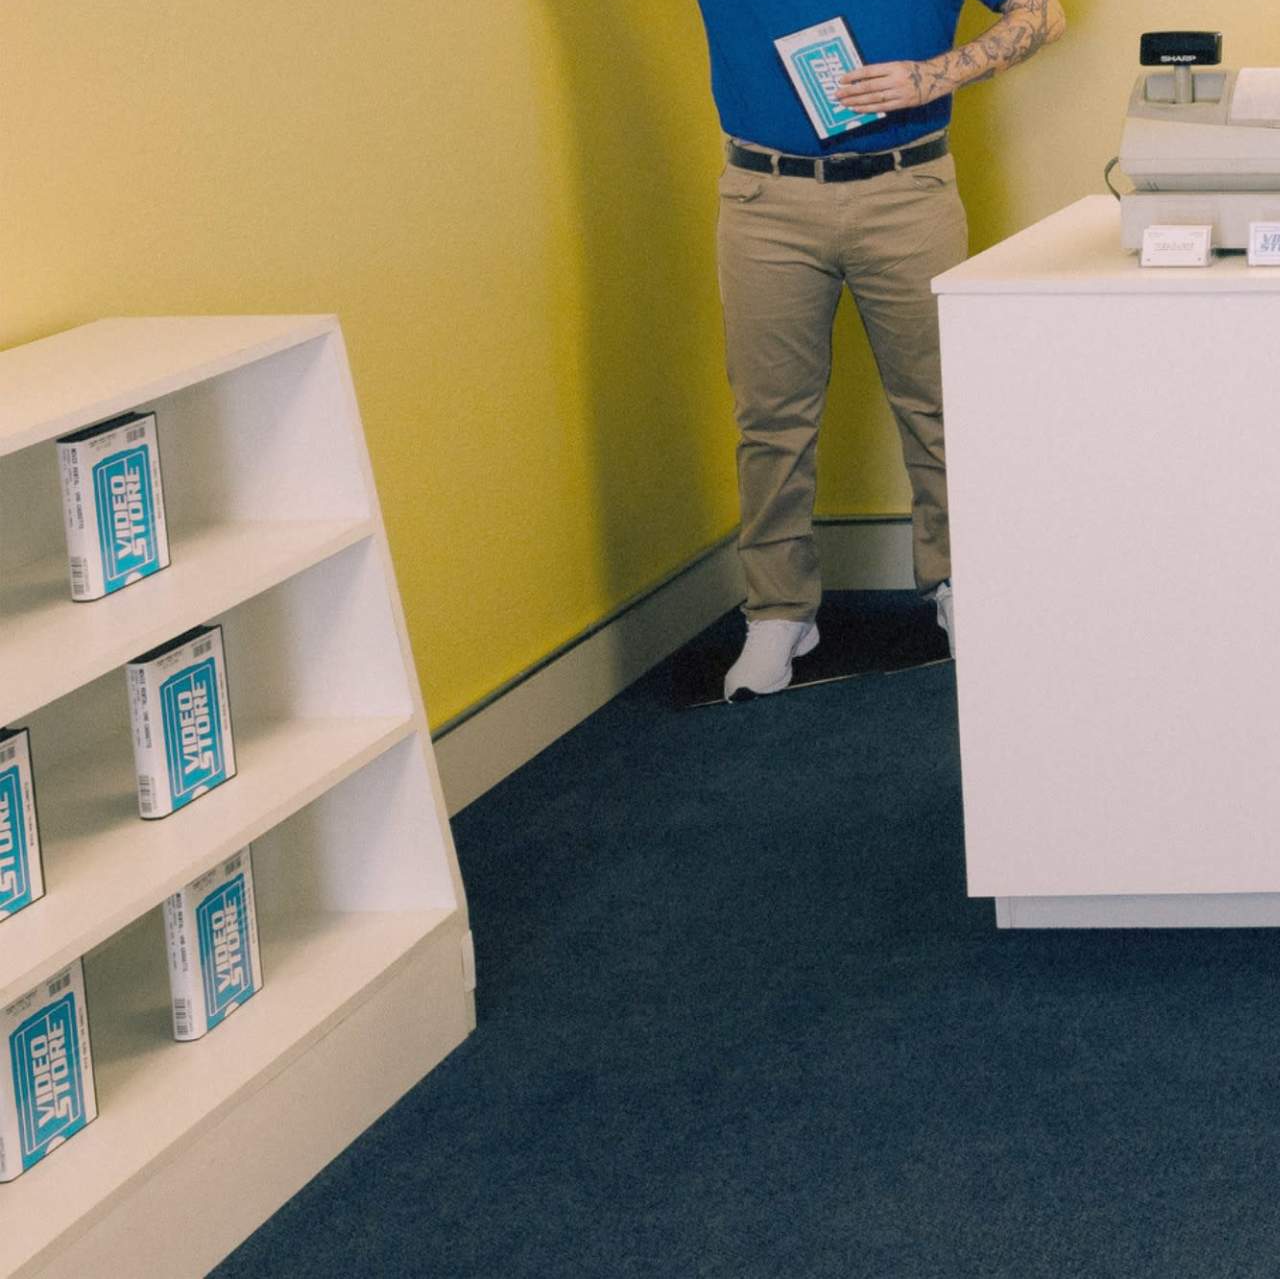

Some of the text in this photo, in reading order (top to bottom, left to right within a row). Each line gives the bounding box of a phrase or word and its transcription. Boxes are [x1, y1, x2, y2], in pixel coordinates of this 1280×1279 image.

[1160, 54, 1197, 63] SHARP
[109, 475, 131, 560] VIDEO
[125, 465, 146, 558] STORE
[177, 690, 199, 774] VIDEO
[193, 679, 215, 770] STORE
[211, 909, 231, 992] VIDEO
[224, 897, 244, 987] STORE
[31, 1034, 54, 1128] VIDEO
[48, 1019, 72, 1119] STORE
